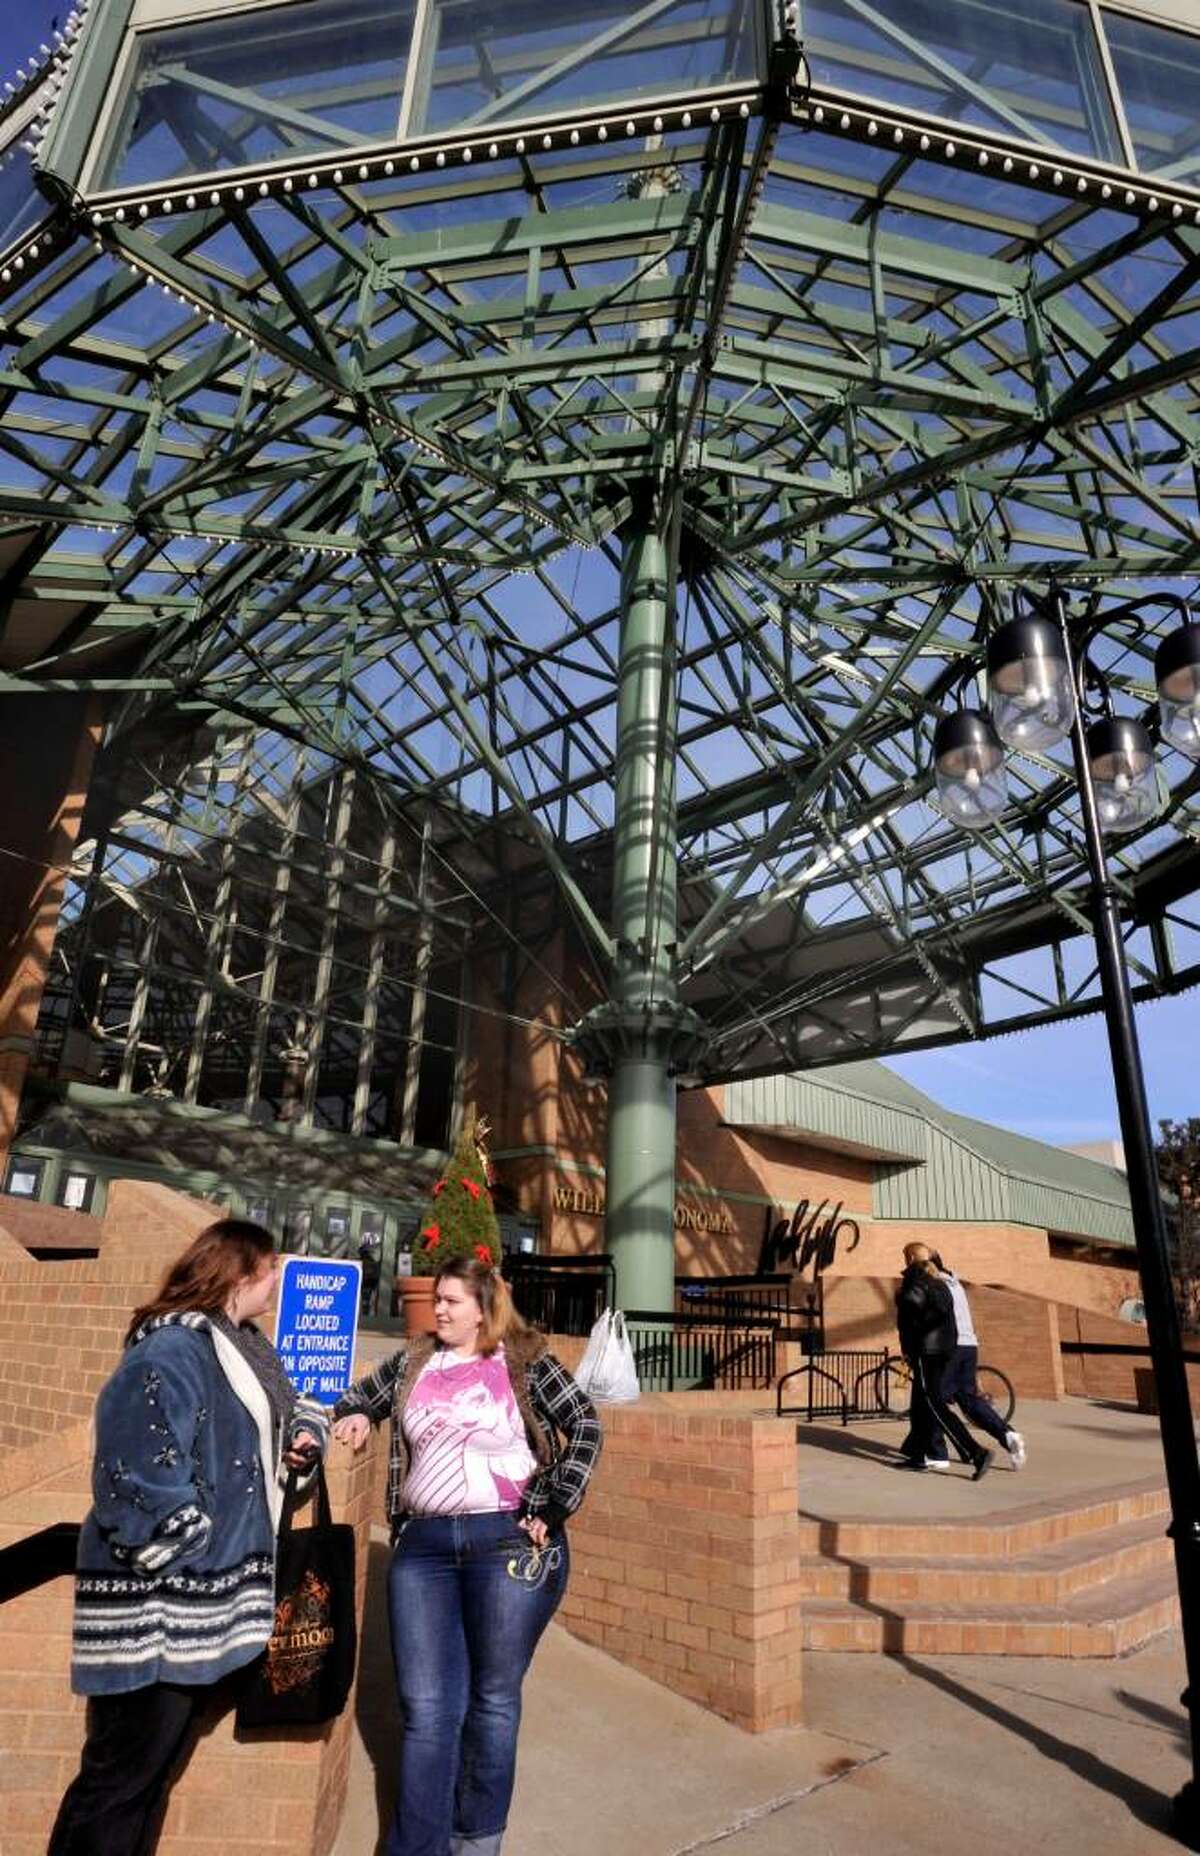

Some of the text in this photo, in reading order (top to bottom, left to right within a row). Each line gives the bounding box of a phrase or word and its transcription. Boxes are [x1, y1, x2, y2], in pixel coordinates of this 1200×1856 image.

[296, 1274, 346, 1291] HANDICAP
[304, 1295, 334, 1310] RAMP
[295, 1315, 339, 1330] LOCATED
[280, 1335, 349, 1351] AT ENTRANCE
[298, 1356, 347, 1371] OPPOSITE
[302, 1377, 316, 1392] OF
[320, 1377, 344, 1392] MALL
